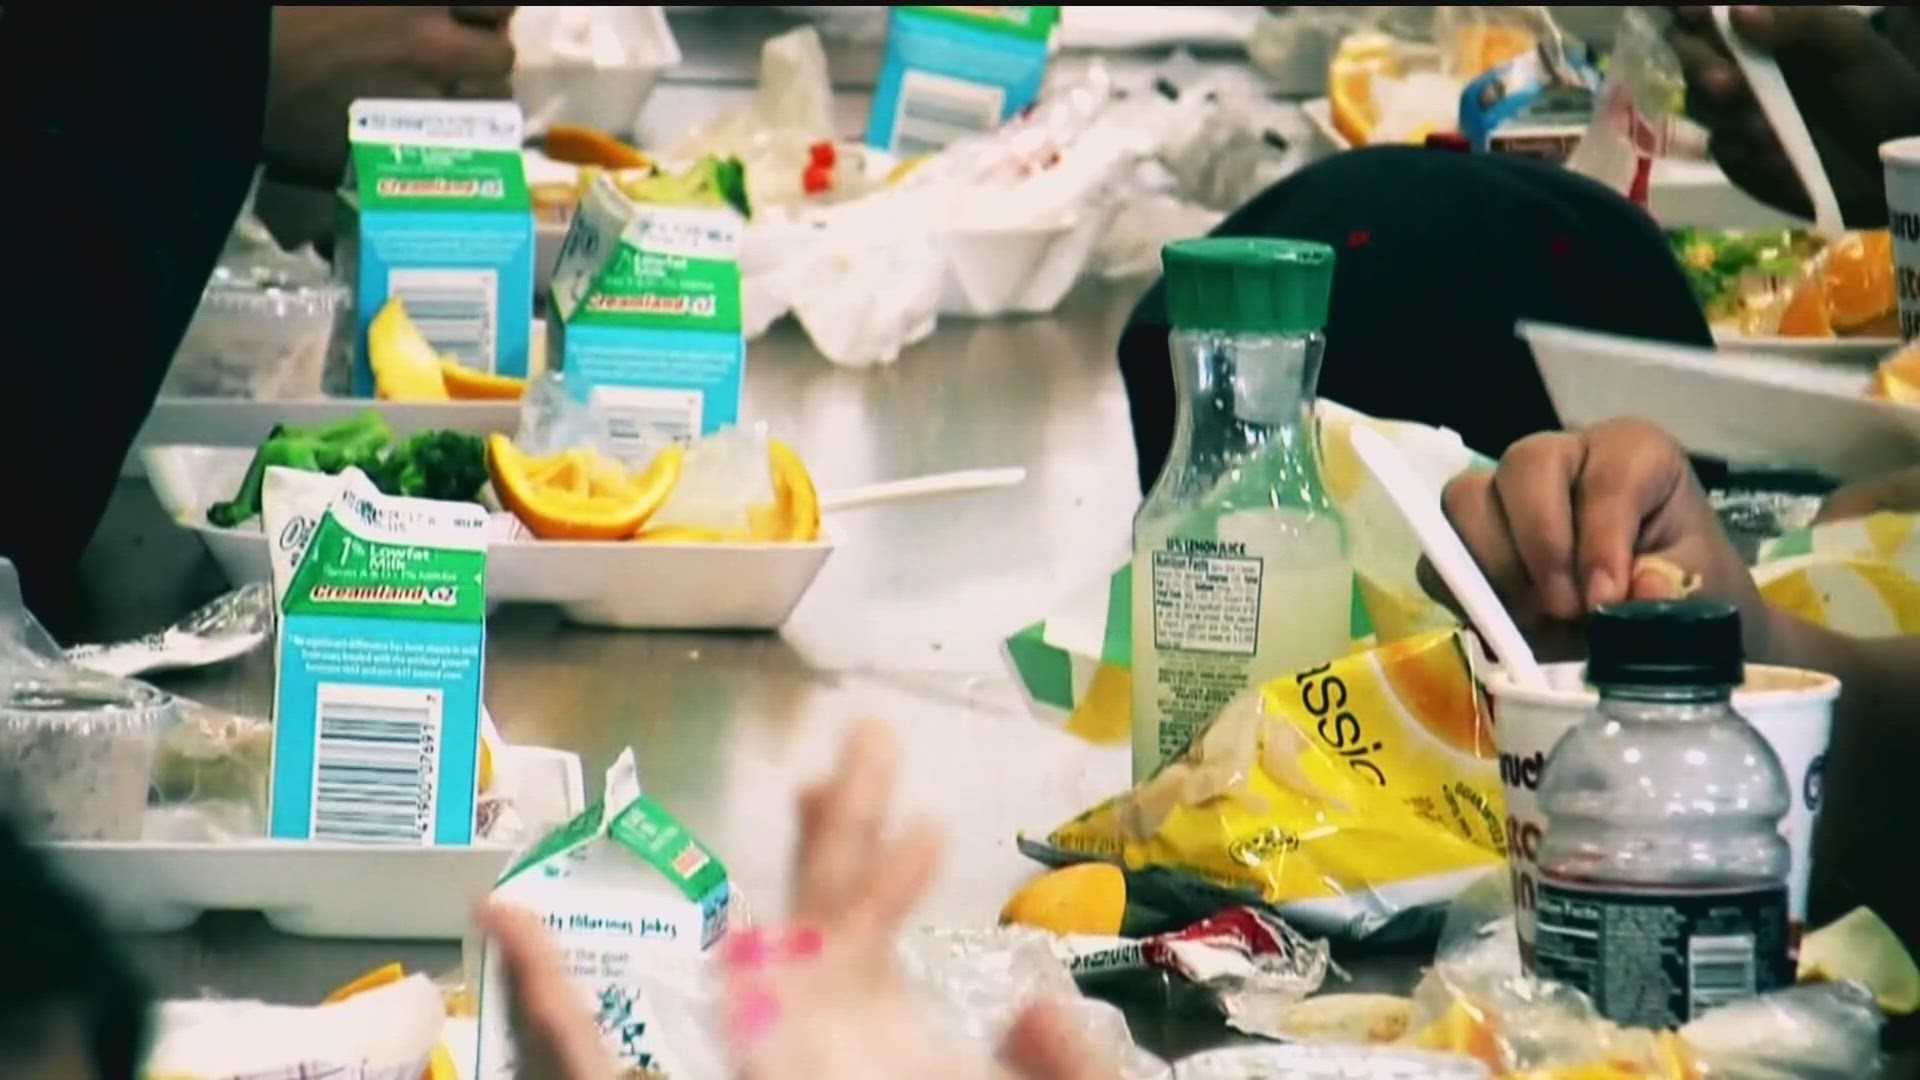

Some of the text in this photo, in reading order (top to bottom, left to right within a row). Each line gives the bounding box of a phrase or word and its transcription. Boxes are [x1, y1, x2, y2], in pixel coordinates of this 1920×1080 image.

[369, 543, 430, 562] Lowfat
[369, 556, 406, 573] Milk
[311, 584, 427, 605] Creamland
